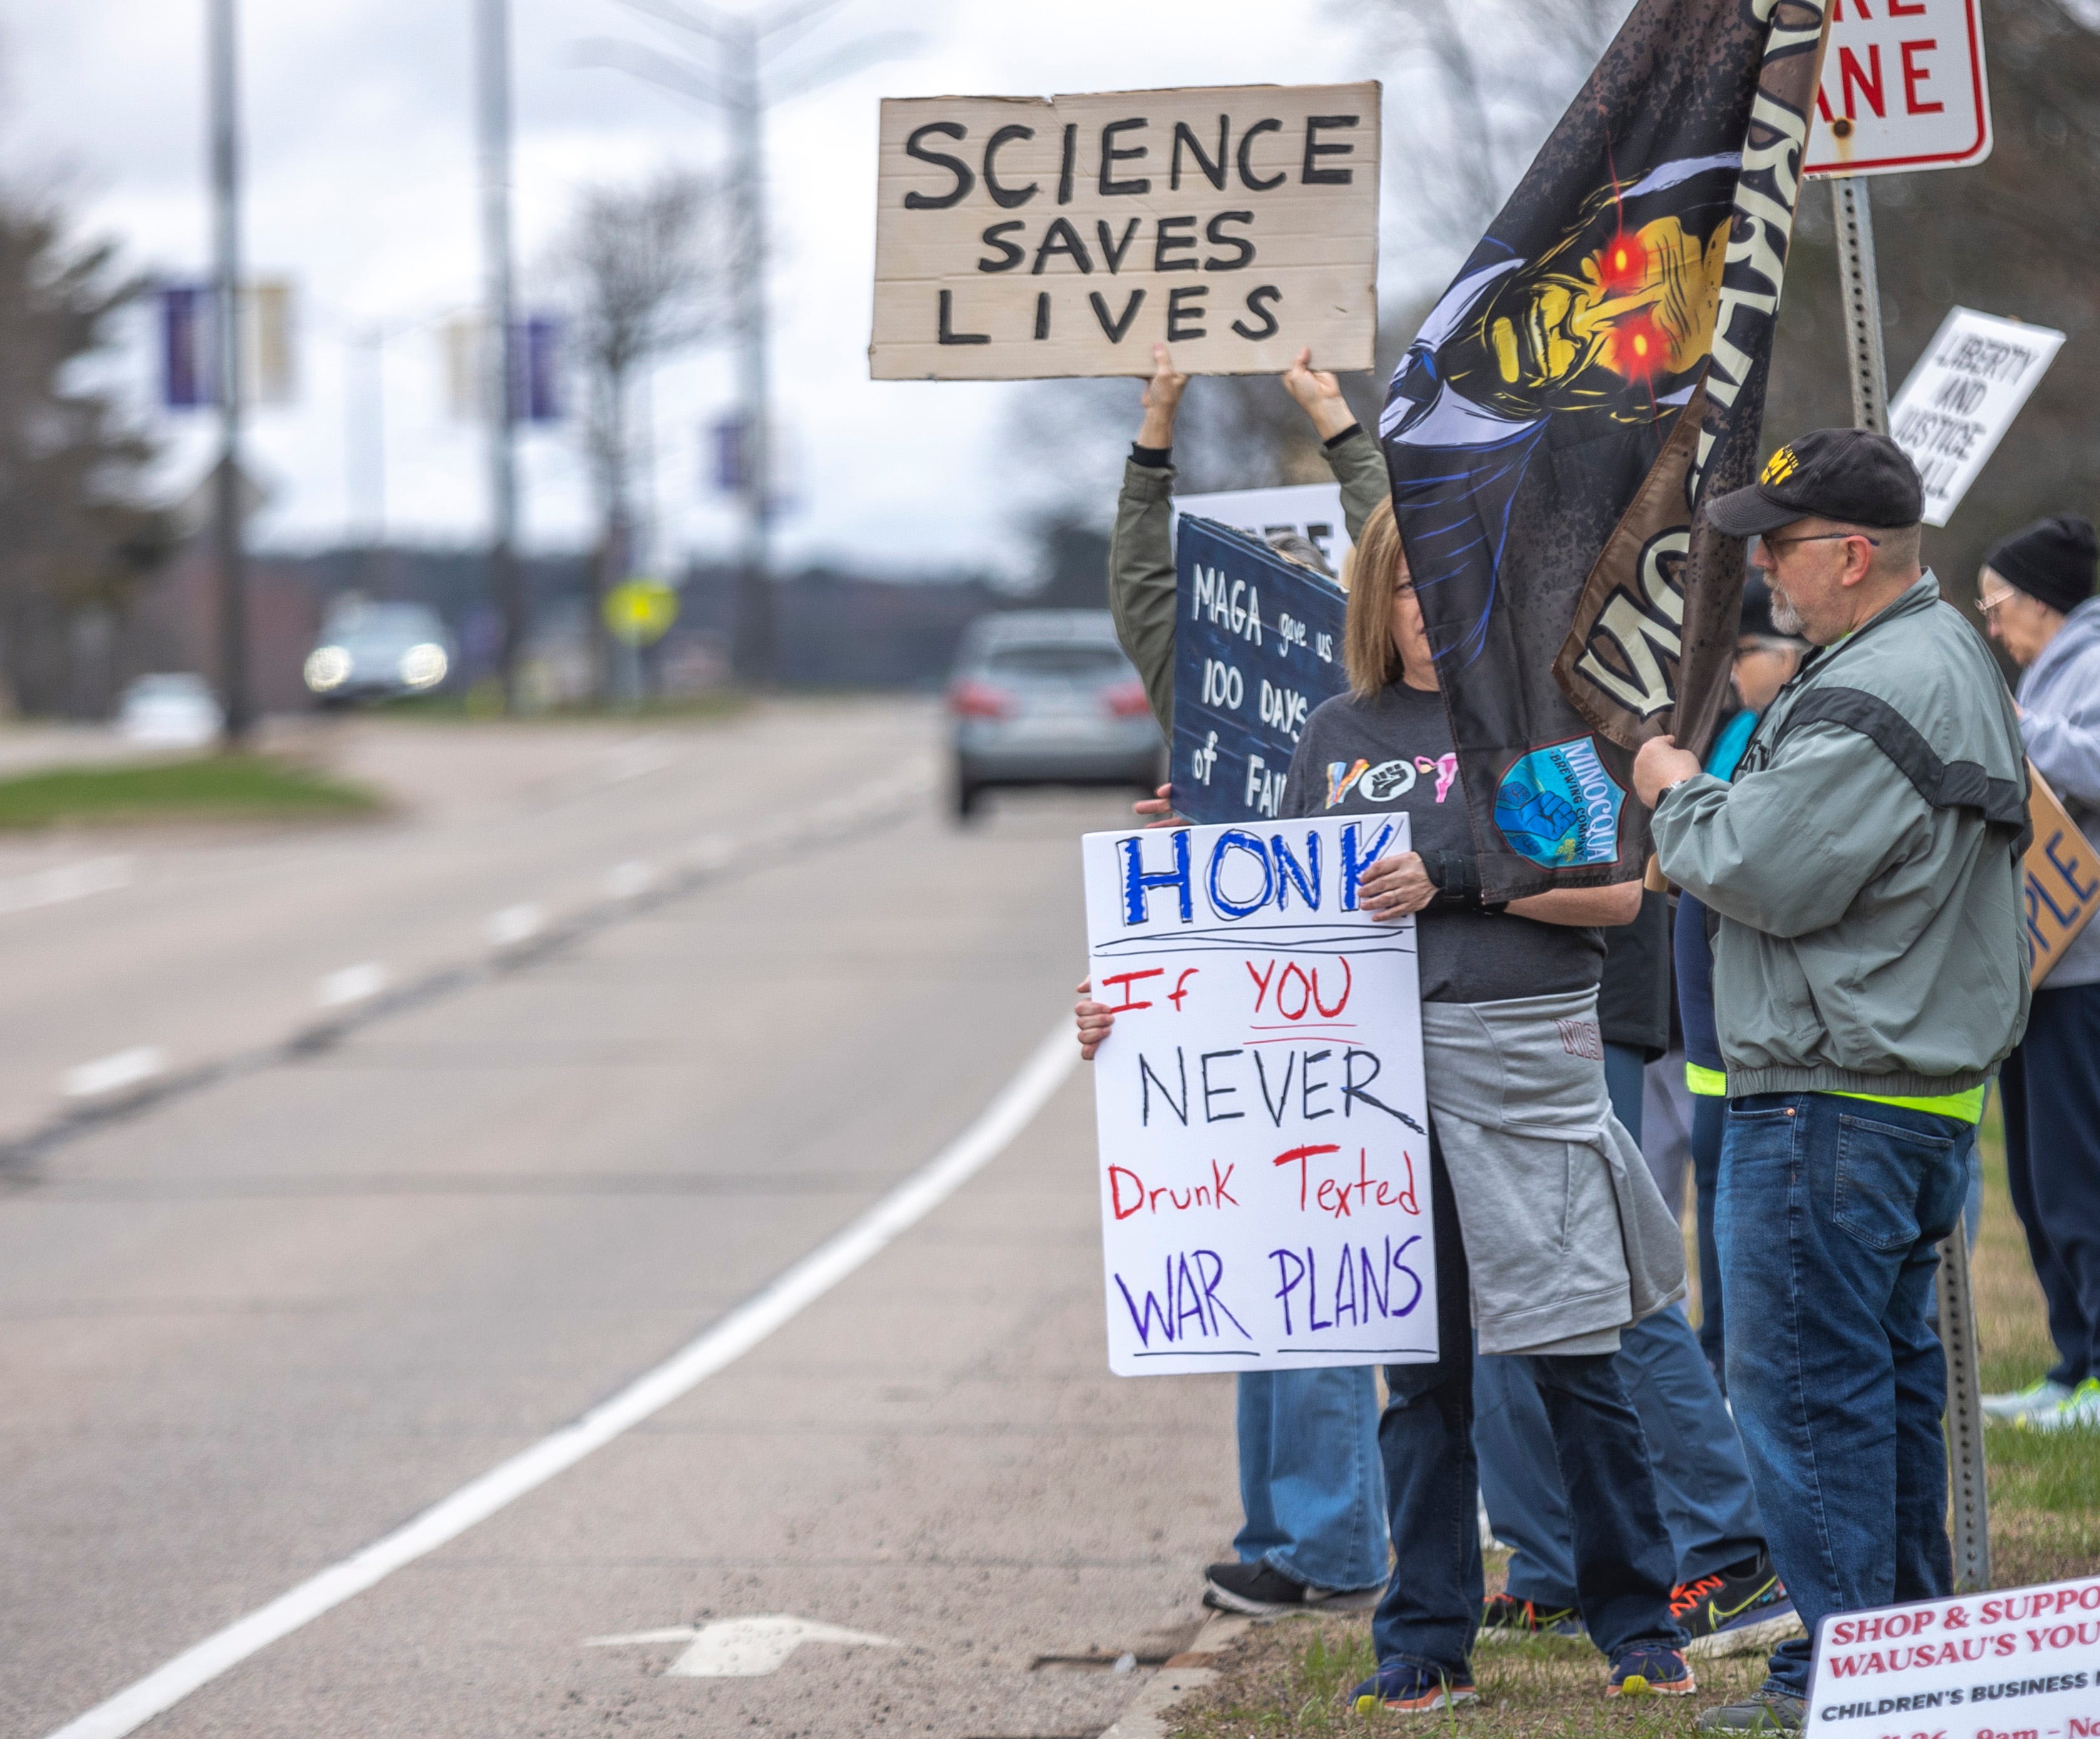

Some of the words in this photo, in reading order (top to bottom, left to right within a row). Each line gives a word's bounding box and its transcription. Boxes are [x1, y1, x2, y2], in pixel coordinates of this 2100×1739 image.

[905, 113, 1360, 210] SCIENCE
[979, 211, 1256, 275] SAVES
[939, 286, 1282, 344] LIVES
[1935, 333, 2039, 386] LIBERTY
[1935, 376, 1988, 416] AND
[1192, 564, 1262, 646] MAGA
[1278, 612, 1307, 657] gave
[1317, 631, 1334, 663] us
[1201, 658, 1243, 710] 100
[1260, 679, 1309, 743] DAYS
[1192, 730, 1218, 787] of
[1550, 755, 1583, 804] BREWING
[1559, 741, 1617, 862] MINOCQUA
[1116, 815, 1408, 927] HONK
[2025, 828, 2099, 969] PLE
[1102, 967, 1199, 1013] If
[1246, 956, 1351, 1020] YOU
[1139, 1046, 1427, 1135] NEVER
[1273, 1144, 1421, 1219] Texted
[1114, 1249, 1252, 1348] WAR
[1269, 1234, 1423, 1335] PLANS
[1831, 1610, 1936, 1646] SHOP
[1943, 1605, 1970, 1630] &
[1979, 1585, 2100, 1625] SUPPO
[1830, 1633, 2017, 1679] WAUSAU'S
[1821, 1689, 1964, 1722] CHILDREN'S
[1971, 1671, 2088, 1703] BUSINESS
